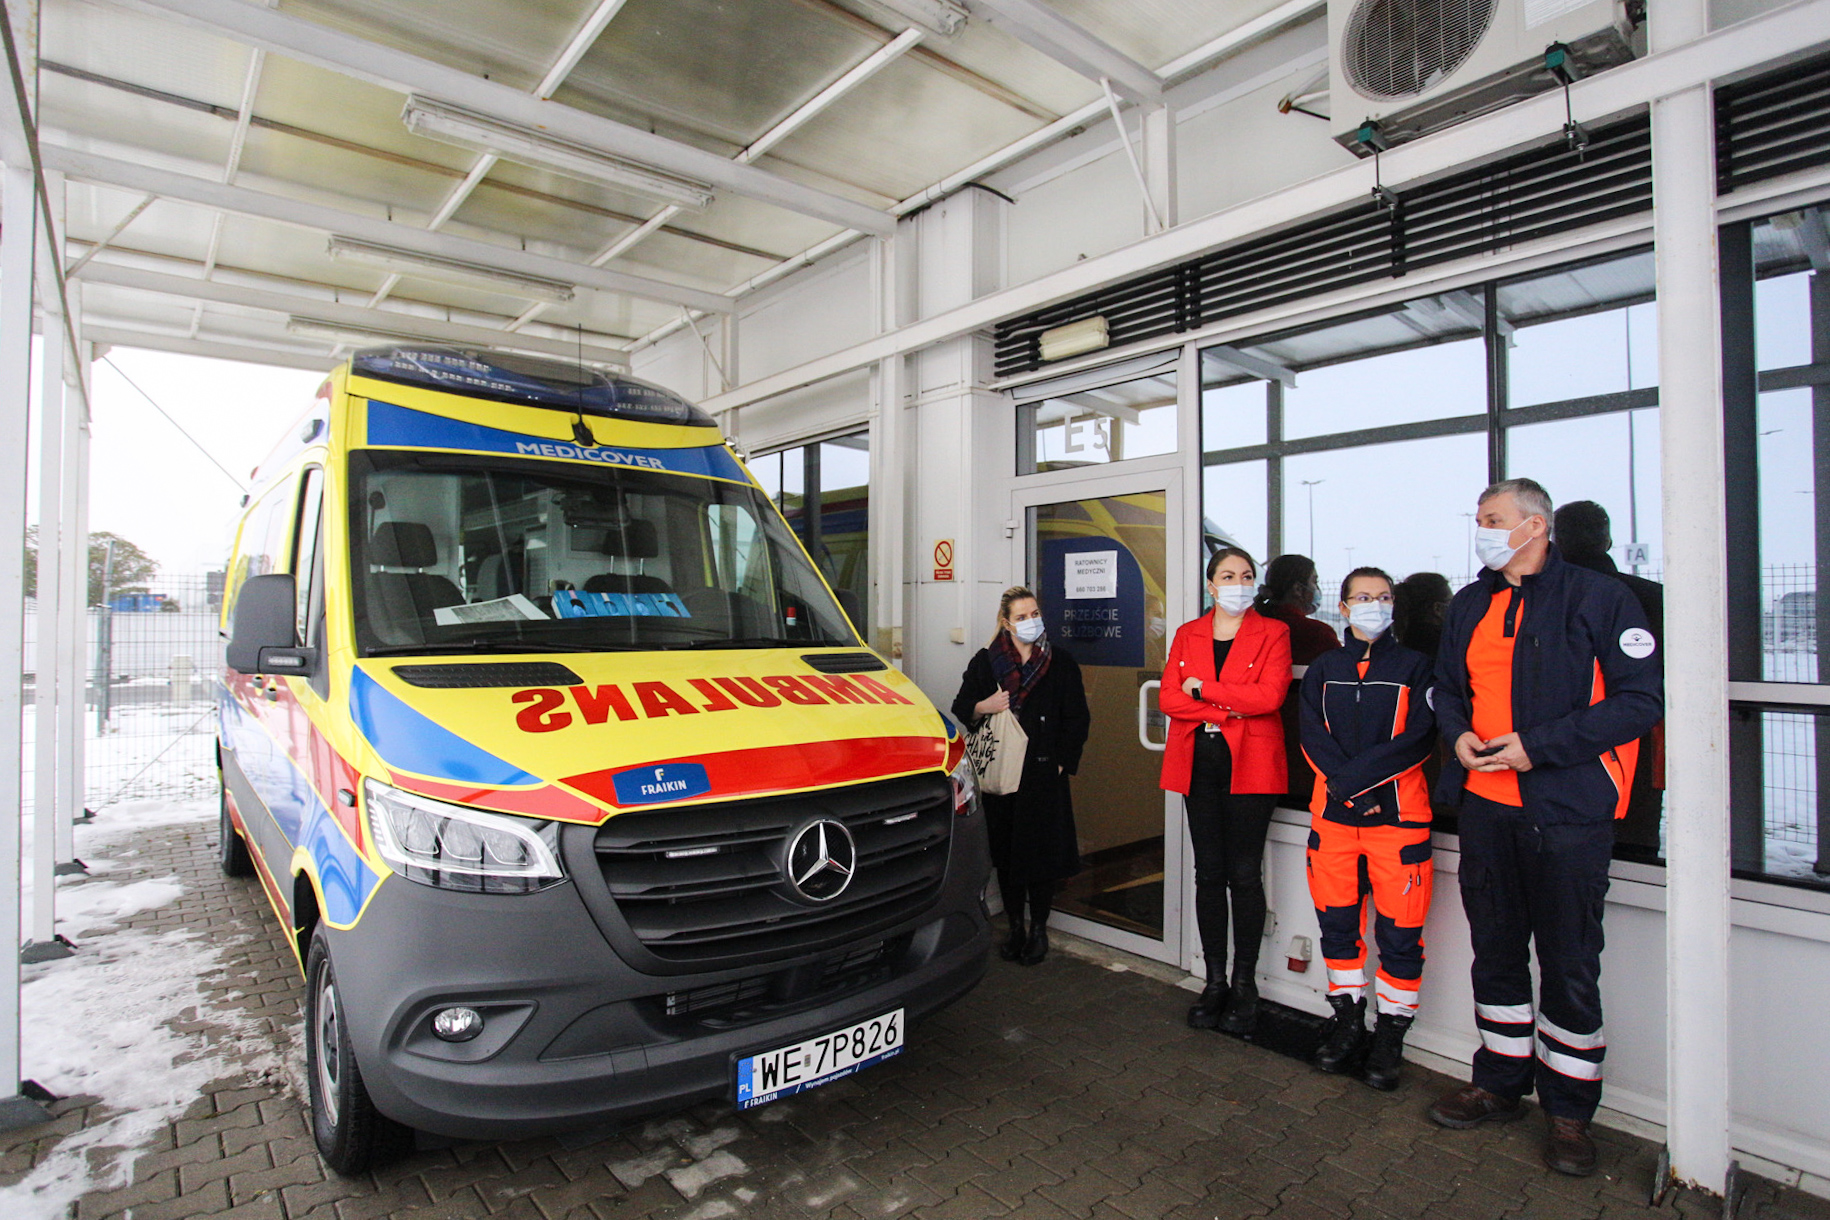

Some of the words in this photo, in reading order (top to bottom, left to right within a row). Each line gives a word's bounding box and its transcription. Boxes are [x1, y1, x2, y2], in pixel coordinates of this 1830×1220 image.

[515, 442, 666, 469] MEDICOVER
[1064, 606, 1119, 621] PRZEJŚCIE
[641, 780, 687, 795] FRAIKIN
[761, 1047, 802, 1090] WE
[815, 1013, 897, 1074] 7P826
[739, 1083, 751, 1094] PL
[750, 1091, 778, 1107] FRAIKIN
